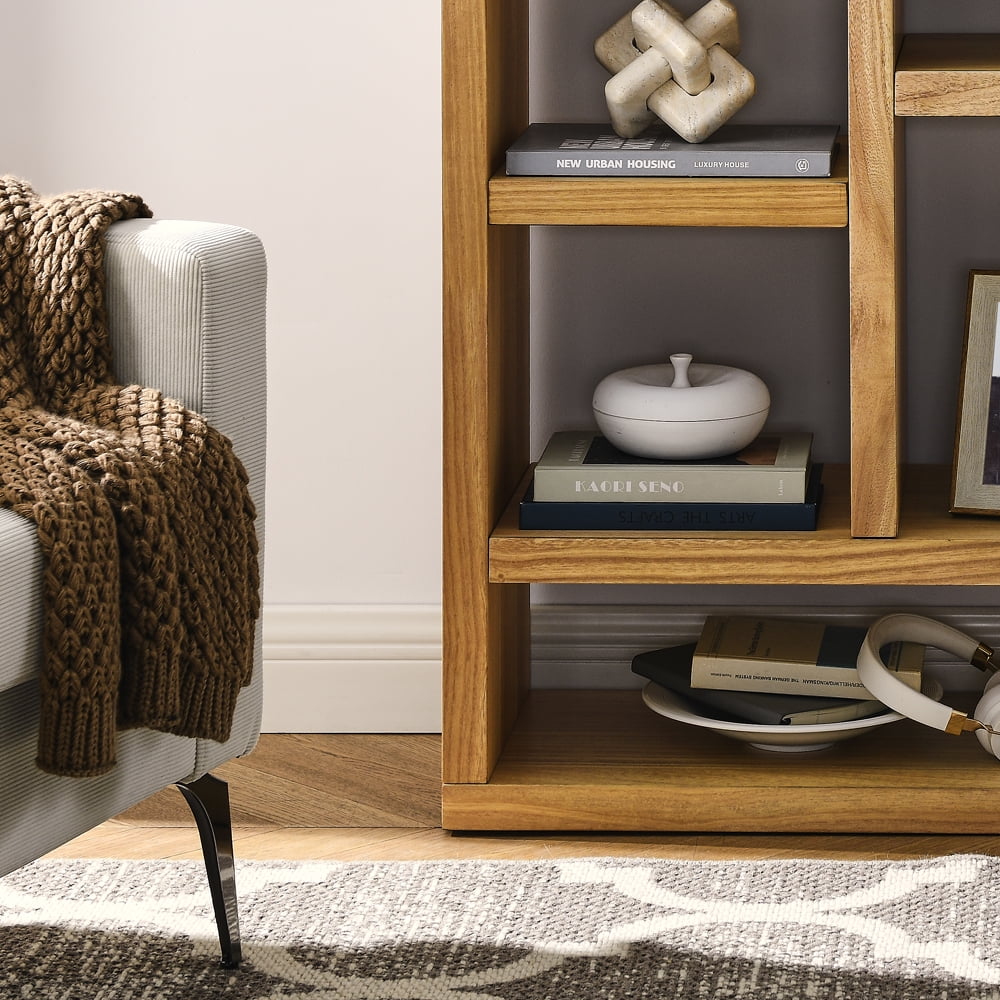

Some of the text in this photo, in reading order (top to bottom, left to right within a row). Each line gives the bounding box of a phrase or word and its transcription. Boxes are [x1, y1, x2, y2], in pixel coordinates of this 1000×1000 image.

[556, 159, 676, 169] NEW URBAN HOUSING
[694, 161, 750, 169] LUXURY HOUSE
[575, 480, 685, 494] KAORI SENO
[618, 510, 756, 524] ARTS THE CRAFTS
